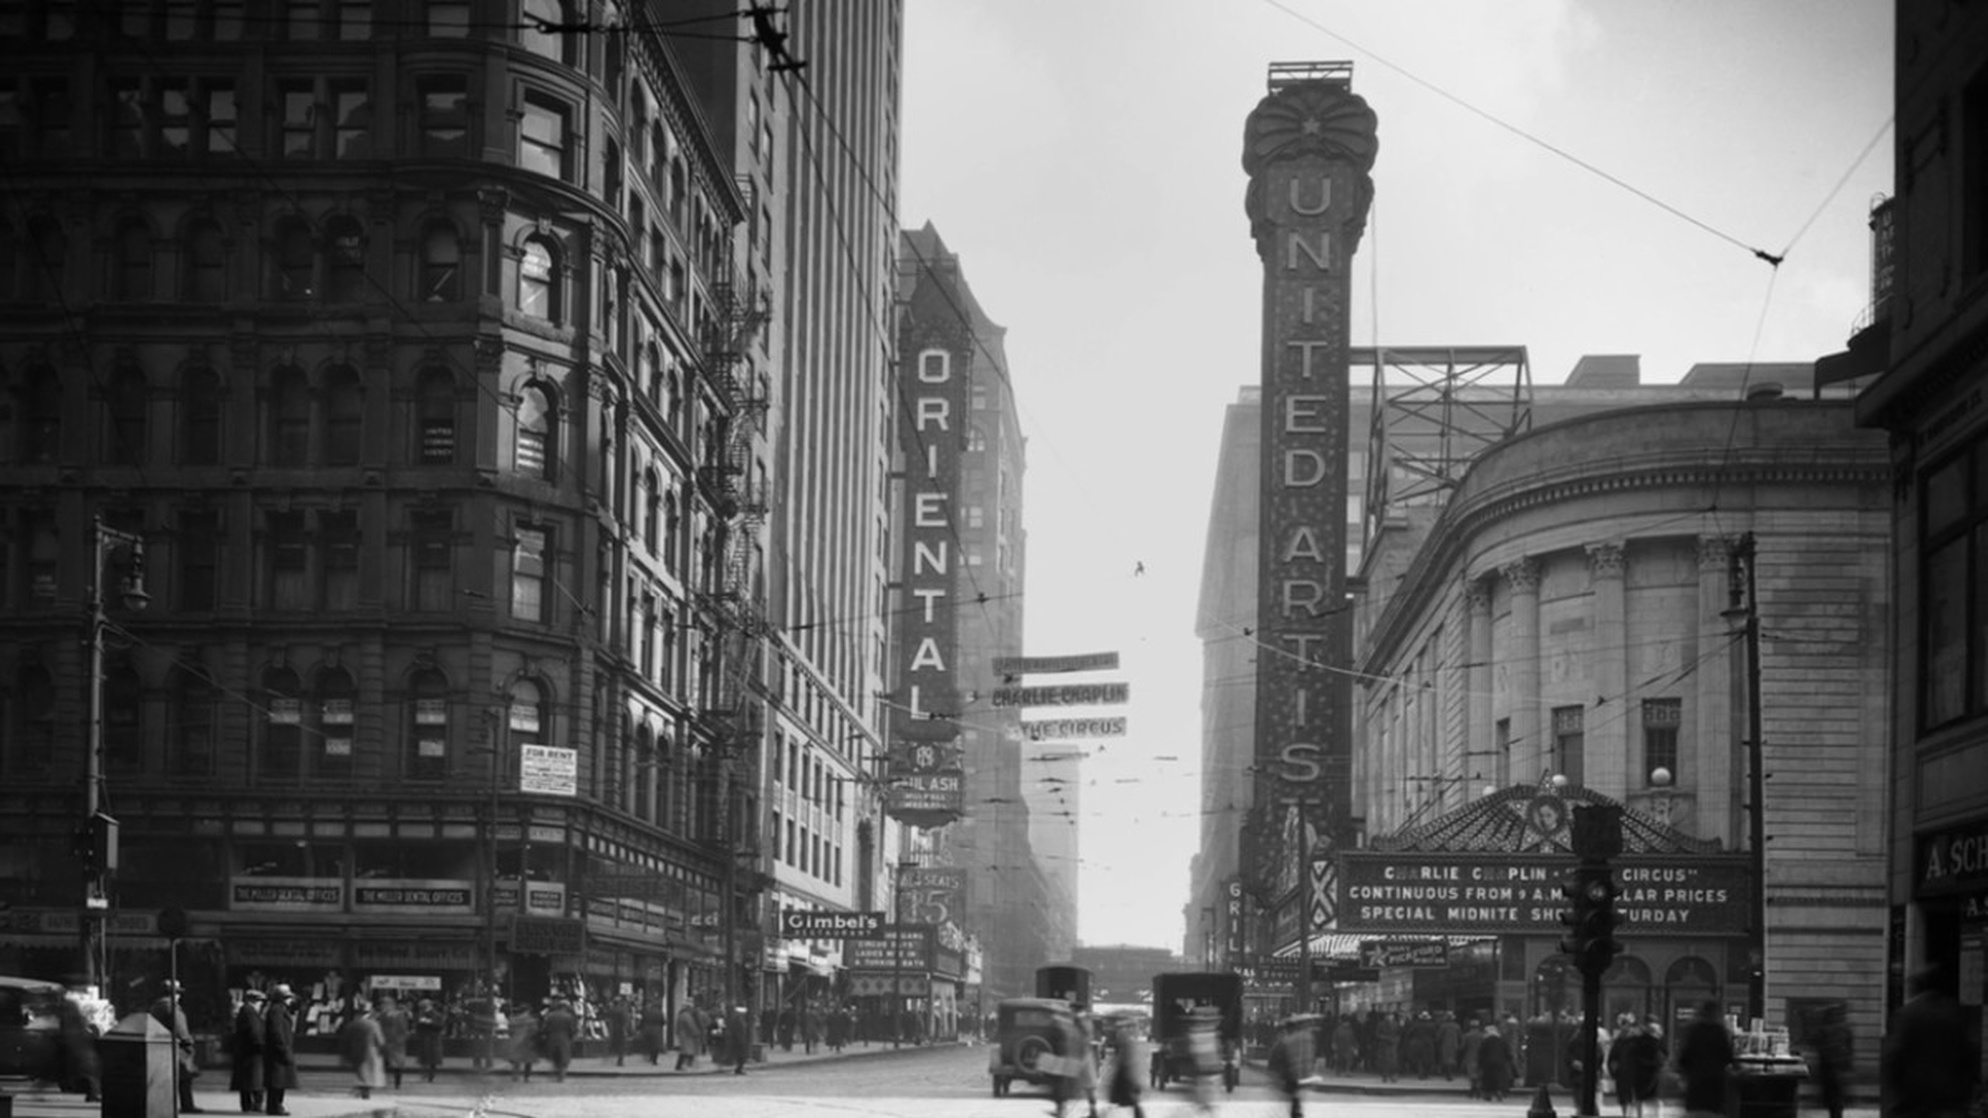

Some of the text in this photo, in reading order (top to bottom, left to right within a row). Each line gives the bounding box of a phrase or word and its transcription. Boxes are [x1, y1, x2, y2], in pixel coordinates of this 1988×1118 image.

[1286, 177, 1331, 486] UNITED
[909, 350, 952, 719] ORIENTAL
[992, 683, 1128, 706] CHARLIE CHAPLIN
[1021, 720, 1123, 737] THE CIRCUS
[929, 776, 959, 791] ASH
[1349, 886, 1459, 900] CONTINUOUS
[1466, 886, 1512, 900] FROM
[1664, 889, 1728, 903] PRICES
[788, 913, 878, 930] Gimbel's
[1360, 907, 1435, 921] SPECIAL
[1447, 907, 1518, 921] MIDNITE
[1531, 907, 1575, 922] SHO
